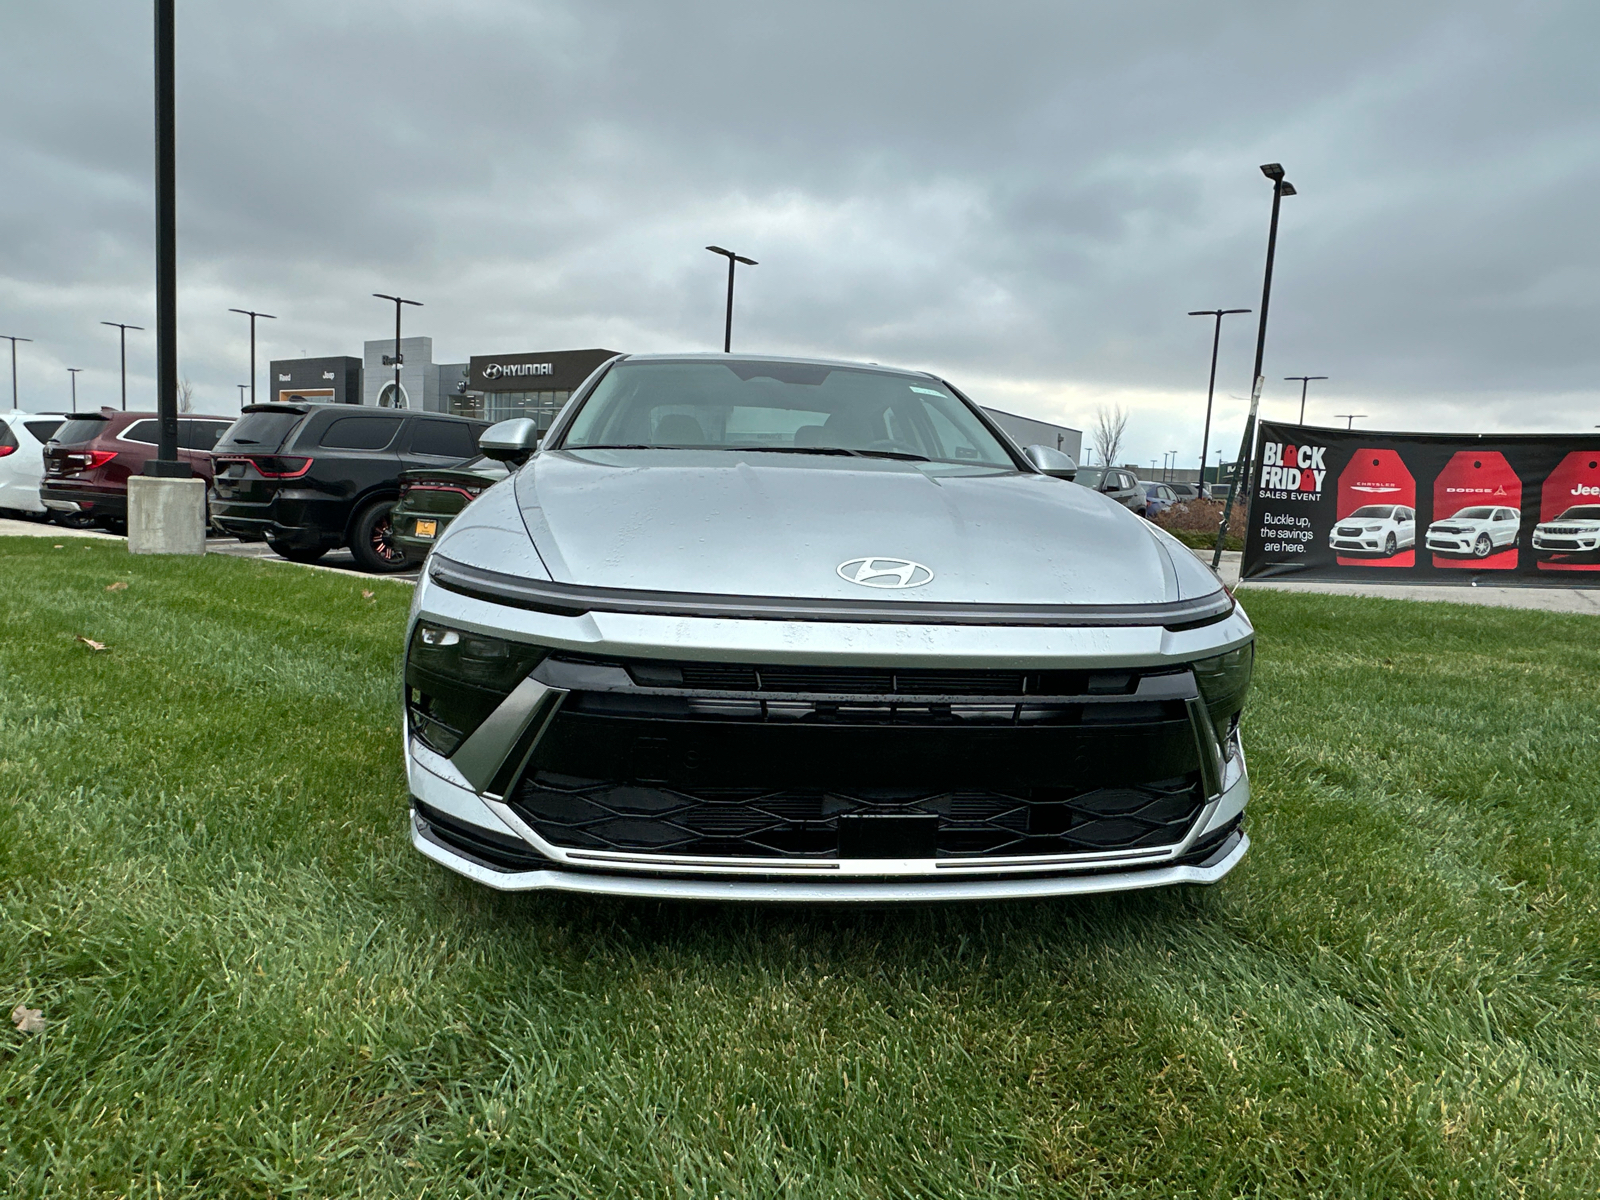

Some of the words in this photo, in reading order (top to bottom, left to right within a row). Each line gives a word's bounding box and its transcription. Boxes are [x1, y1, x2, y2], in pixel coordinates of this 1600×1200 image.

[502, 362, 554, 377] HYUNDAI
[1263, 441, 1327, 470] BLACK
[1260, 465, 1327, 492] FRIDAY
[1259, 490, 1288, 500] SALES
[1290, 492, 1322, 502] EVENT
[1570, 483, 1600, 498] Jee
[1264, 512, 1295, 526] Buckle
[1295, 517, 1311, 529] up,
[1260, 526, 1276, 538] the
[1277, 528, 1314, 542] savings
[1264, 542, 1280, 552] are
[1281, 540, 1307, 553] here.
